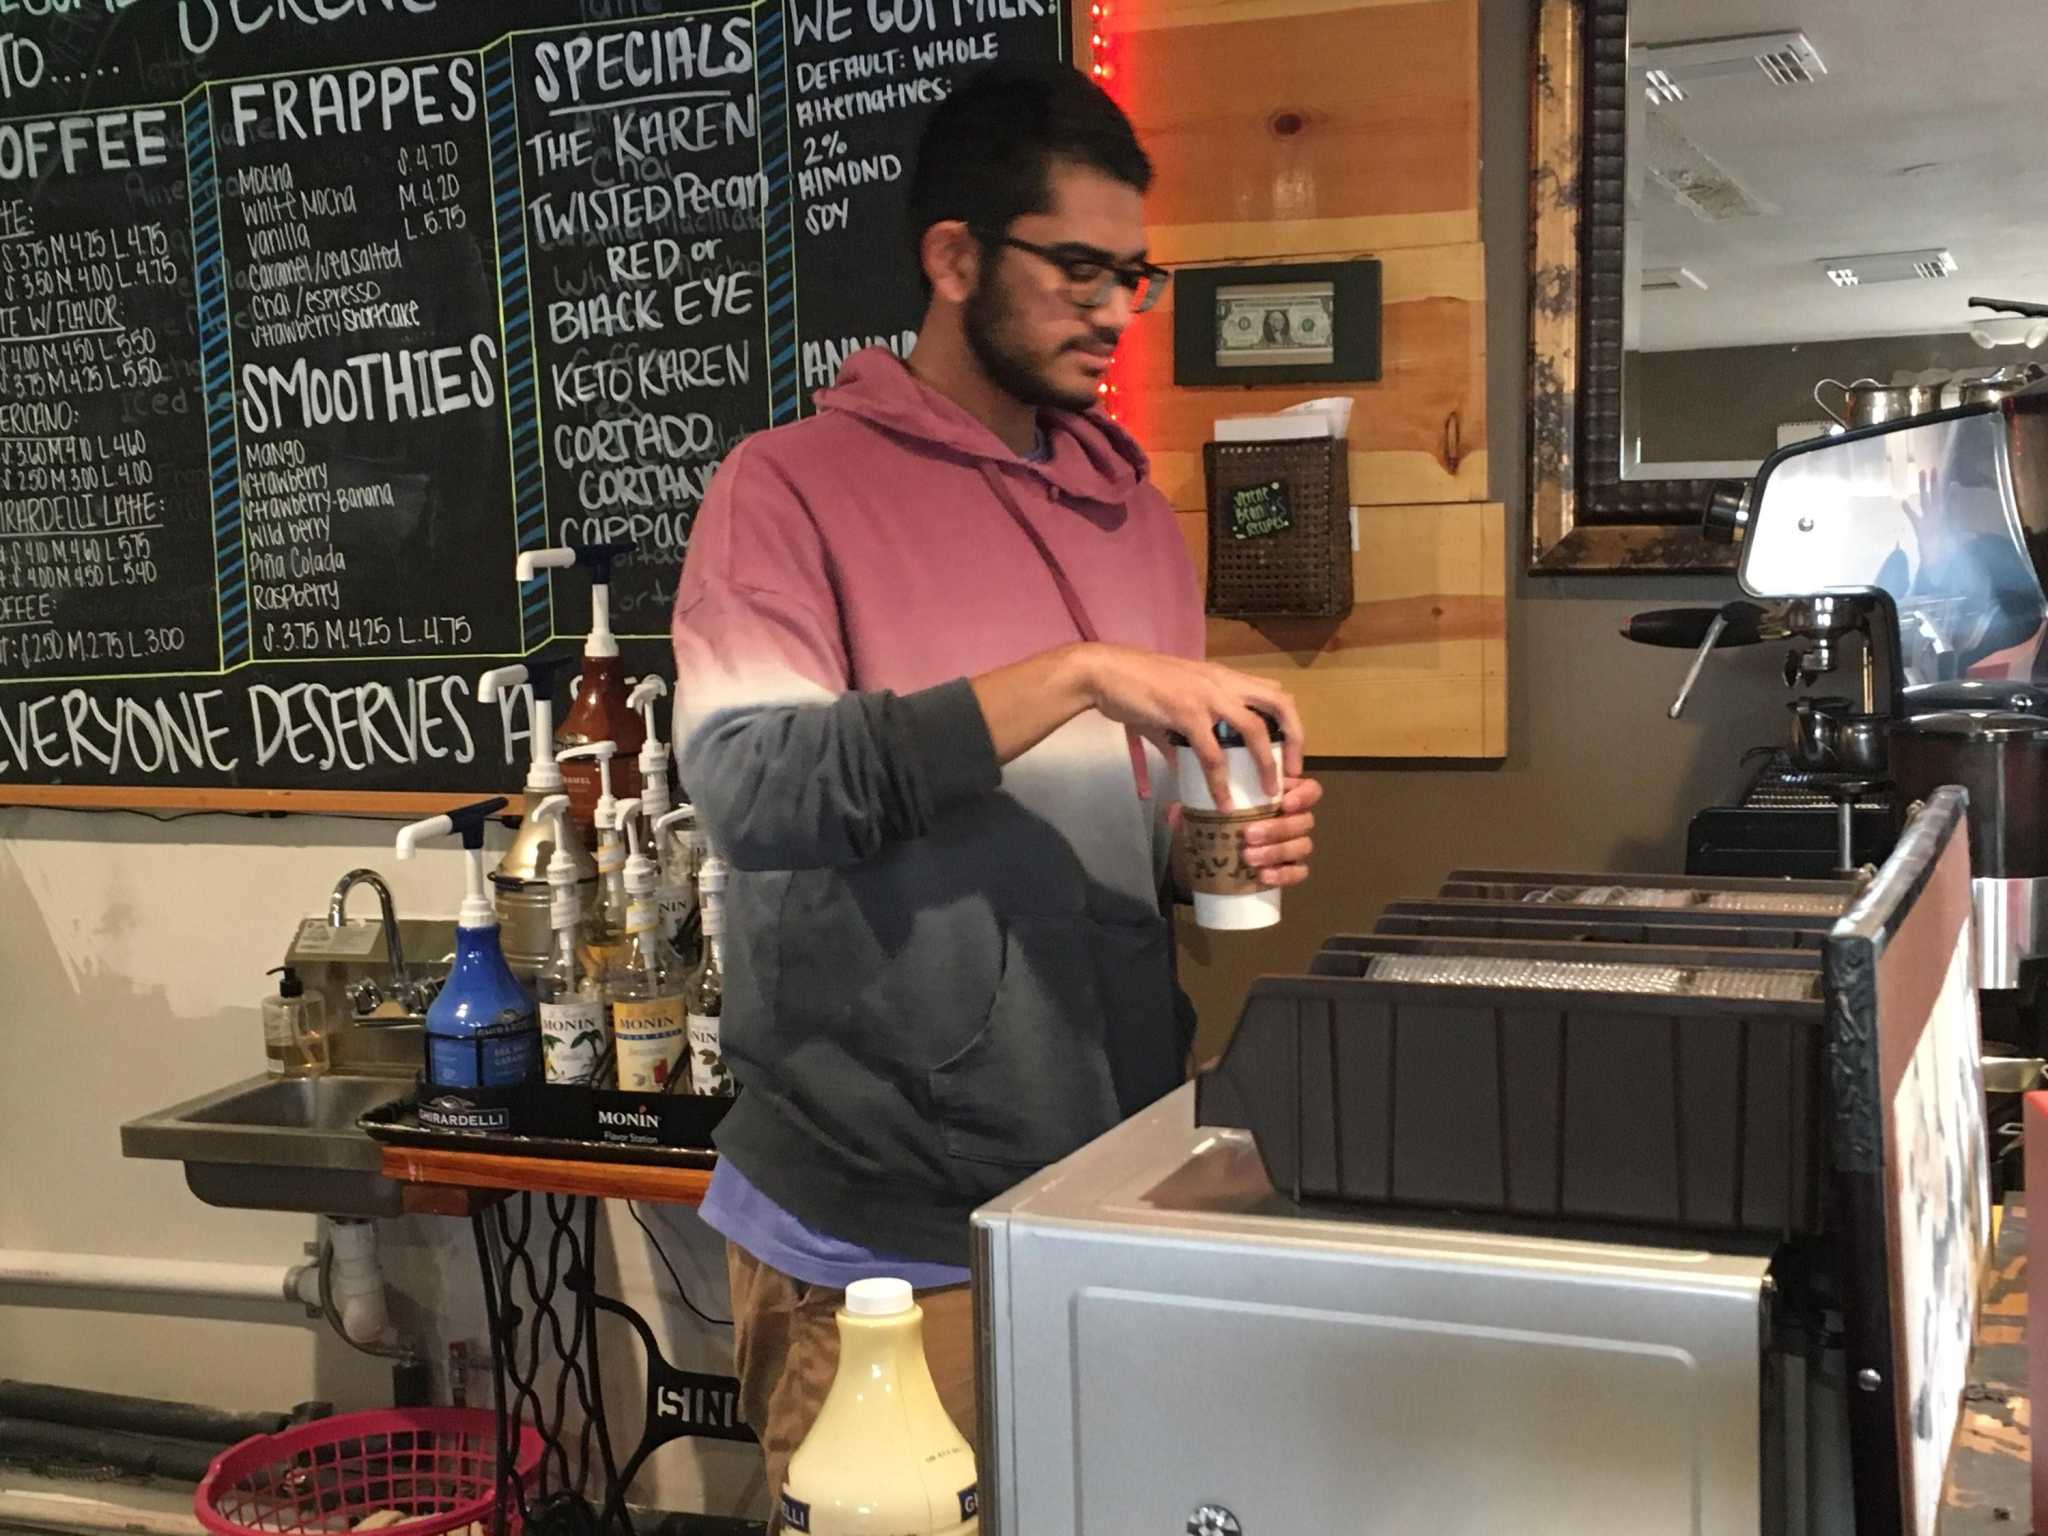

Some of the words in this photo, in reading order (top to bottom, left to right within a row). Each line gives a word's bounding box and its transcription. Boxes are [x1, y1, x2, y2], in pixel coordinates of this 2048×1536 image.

[535, 17, 753, 103] SPECIALS
[796, 49, 905, 94] DEFAULT:
[913, 32, 999, 71] WHOLE
[230, 57, 477, 147] FRAPPES
[526, 128, 593, 177] THE
[612, 94, 756, 167] KAREN
[804, 131, 848, 166] 2%
[528, 184, 672, 243] TWISTED
[804, 198, 849, 236] SOY
[606, 238, 681, 283] RED
[691, 238, 722, 261] or
[674, 271, 753, 325] EYE
[242, 334, 497, 433] SMOOTHIES
[552, 360, 632, 411] KETO
[638, 340, 749, 399] KAREN
[554, 413, 713, 470] CORTADO
[579, 461, 720, 510] CORTAN
[0, 688, 239, 775] VERYONE
[248, 675, 475, 771] DESERVES
[542, 1015, 596, 1032] MONIN
[619, 1017, 675, 1030] MONIN
[418, 1109, 504, 1127] GHIRARDELLI
[597, 1108, 660, 1129] MONIN
